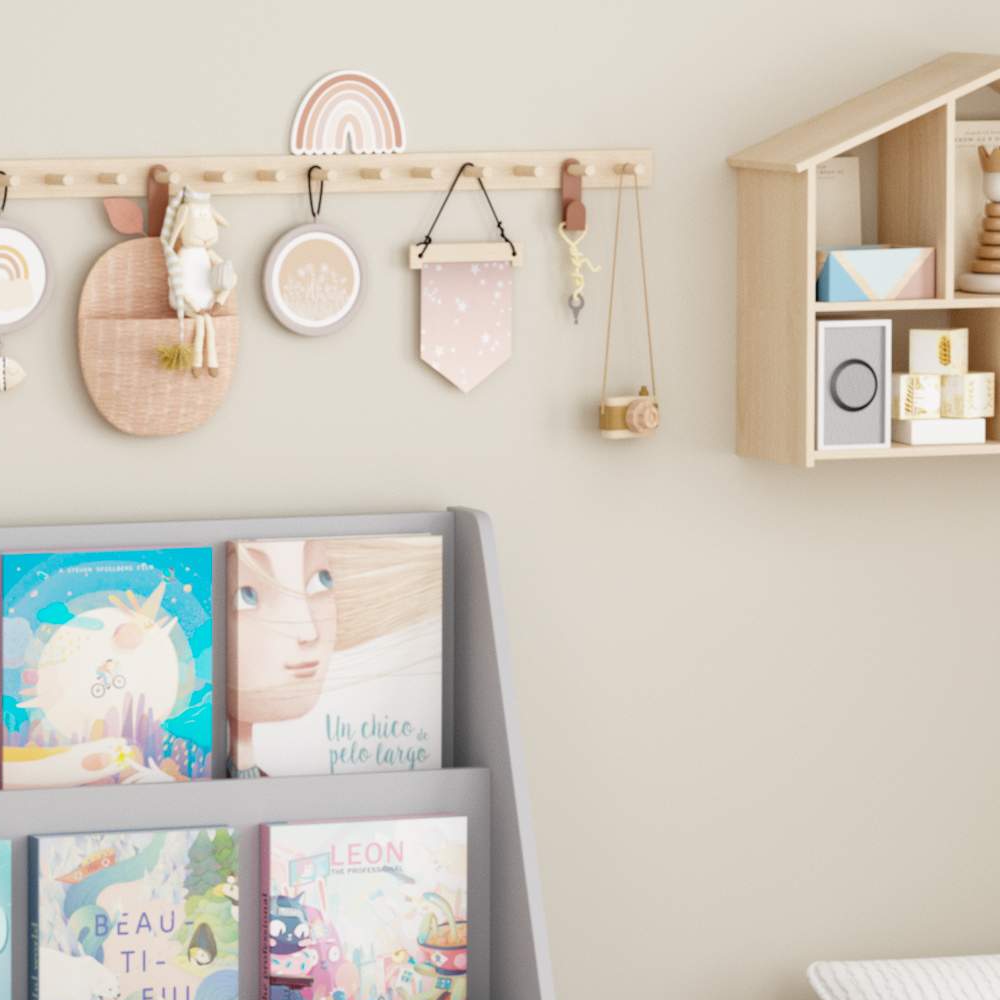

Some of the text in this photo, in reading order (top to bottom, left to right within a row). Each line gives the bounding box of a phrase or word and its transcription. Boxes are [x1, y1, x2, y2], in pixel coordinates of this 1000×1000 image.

[325, 713, 428, 742] Un chico de
[329, 741, 430, 774] pelo largo
[330, 841, 404, 866] LEON
[94, 910, 195, 937] BEAU-
[120, 949, 166, 973] TI-
